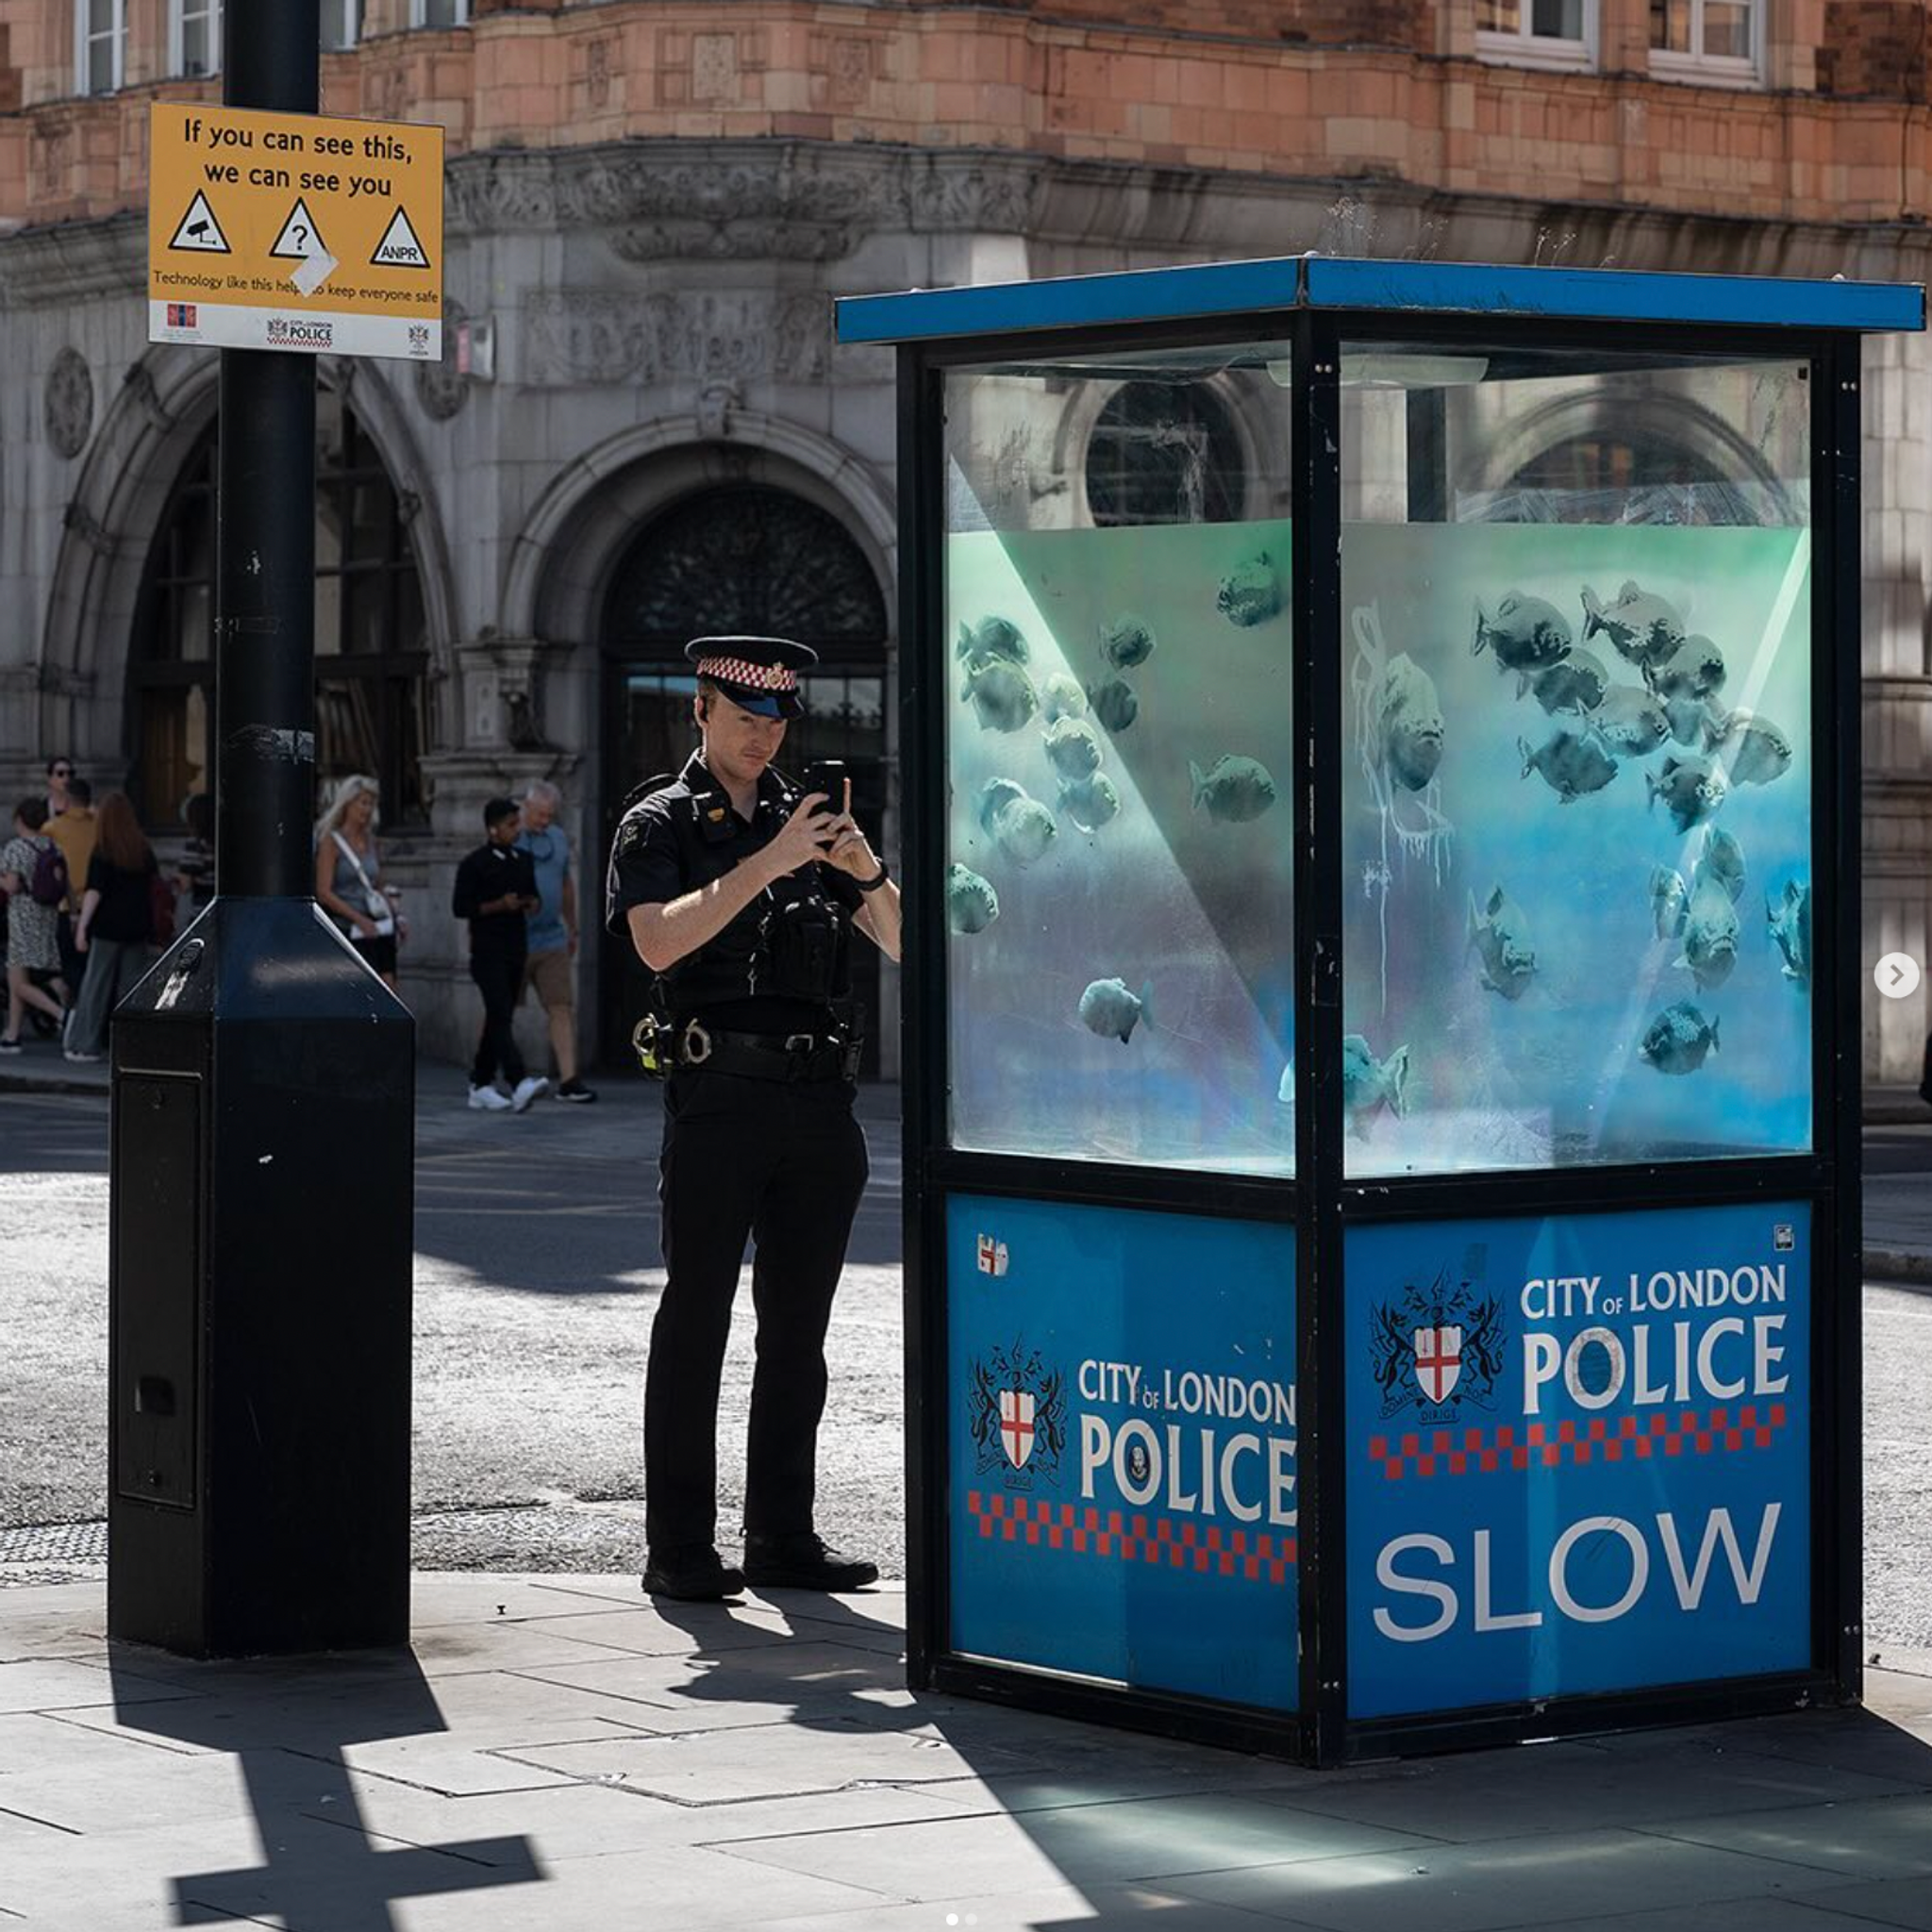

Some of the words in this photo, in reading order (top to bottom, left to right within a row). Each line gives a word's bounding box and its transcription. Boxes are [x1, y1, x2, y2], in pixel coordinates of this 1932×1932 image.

[184, 118, 202, 142] If
[208, 127, 253, 148] you
[263, 132, 304, 151] can
[314, 136, 354, 155] see
[363, 135, 412, 164] this,
[205, 164, 239, 183] we
[249, 168, 290, 187] can
[300, 172, 340, 192] see
[349, 175, 391, 197] you
[380, 245, 418, 260] ANPR
[154, 271, 223, 290] Technology
[227, 275, 247, 289] like
[251, 277, 272, 291] this
[311, 285, 325, 295] o
[327, 283, 356, 300] keep
[359, 287, 412, 302] everyone
[416, 290, 439, 303] safe
[290, 326, 332, 341] POLICE
[1520, 1276, 1602, 1320] CITY
[1603, 1297, 1624, 1316] OF
[1630, 1264, 1787, 1313] LONDON
[1522, 1314, 1790, 1415] POLICE
[1078, 1358, 1141, 1406] CITY
[1142, 1391, 1159, 1409] OF
[1164, 1369, 1296, 1425] LONDON
[1080, 1413, 1297, 1527] POLICE
[1372, 1502, 1782, 1642] SLOW
